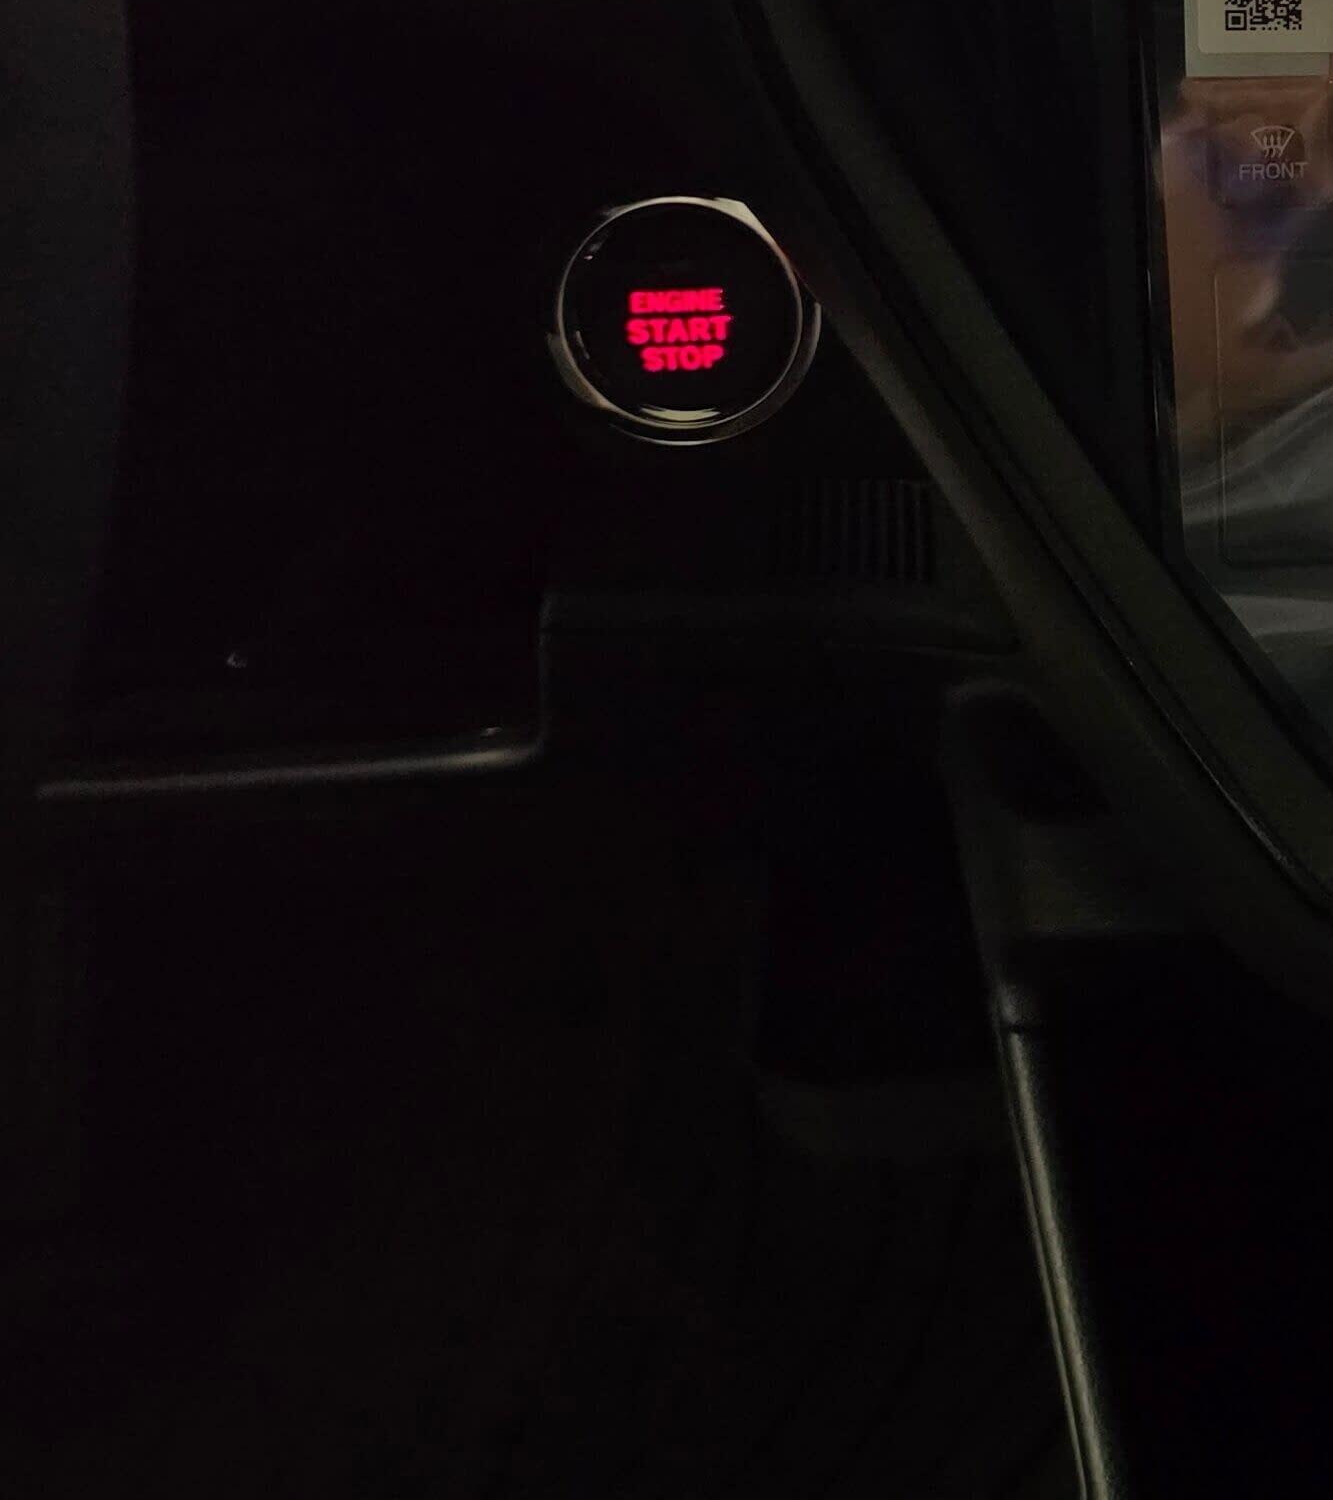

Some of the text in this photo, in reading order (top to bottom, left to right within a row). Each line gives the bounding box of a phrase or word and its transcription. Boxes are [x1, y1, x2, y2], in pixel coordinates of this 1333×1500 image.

[1238, 161, 1309, 181] FRONT
[629, 288, 725, 314] ENGINE
[626, 315, 732, 346] START
[641, 345, 725, 372] STOP
